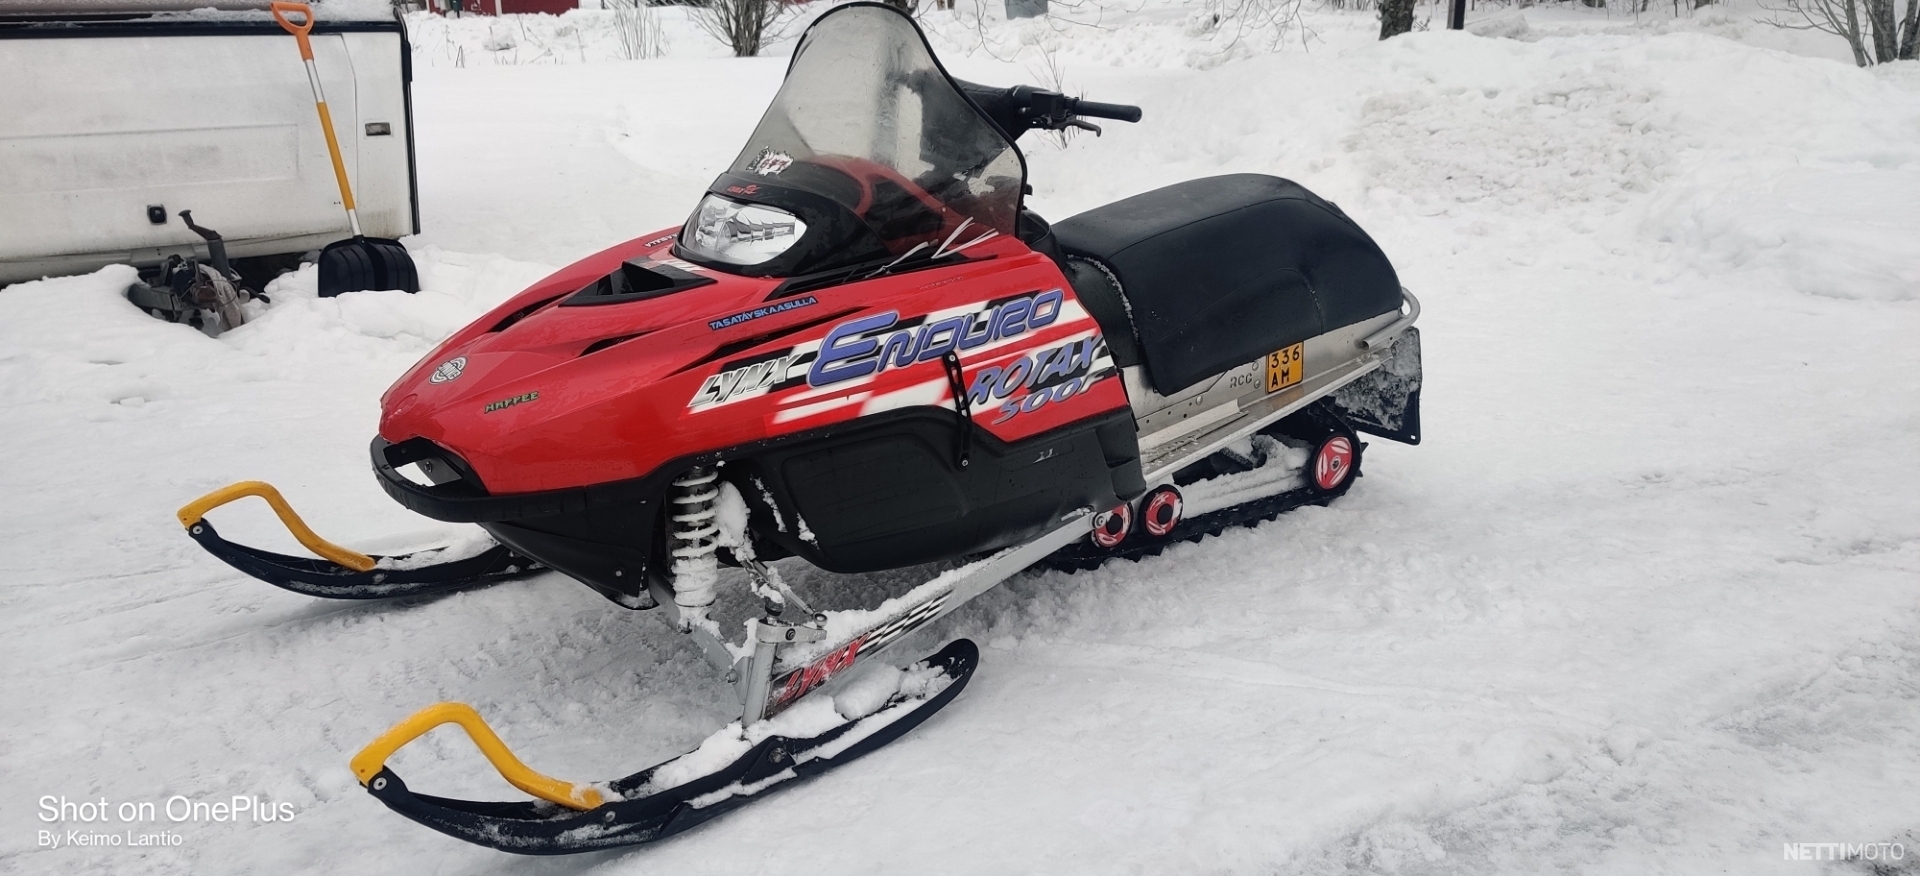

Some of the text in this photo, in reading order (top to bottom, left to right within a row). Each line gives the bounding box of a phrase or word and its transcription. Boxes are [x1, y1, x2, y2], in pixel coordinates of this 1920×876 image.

[688, 352, 804, 408] LYNX
[967, 332, 1105, 405] ROTAX
[1271, 345, 1300, 369] 336
[1271, 367, 1290, 388] AM
[774, 632, 872, 706] LYNX
